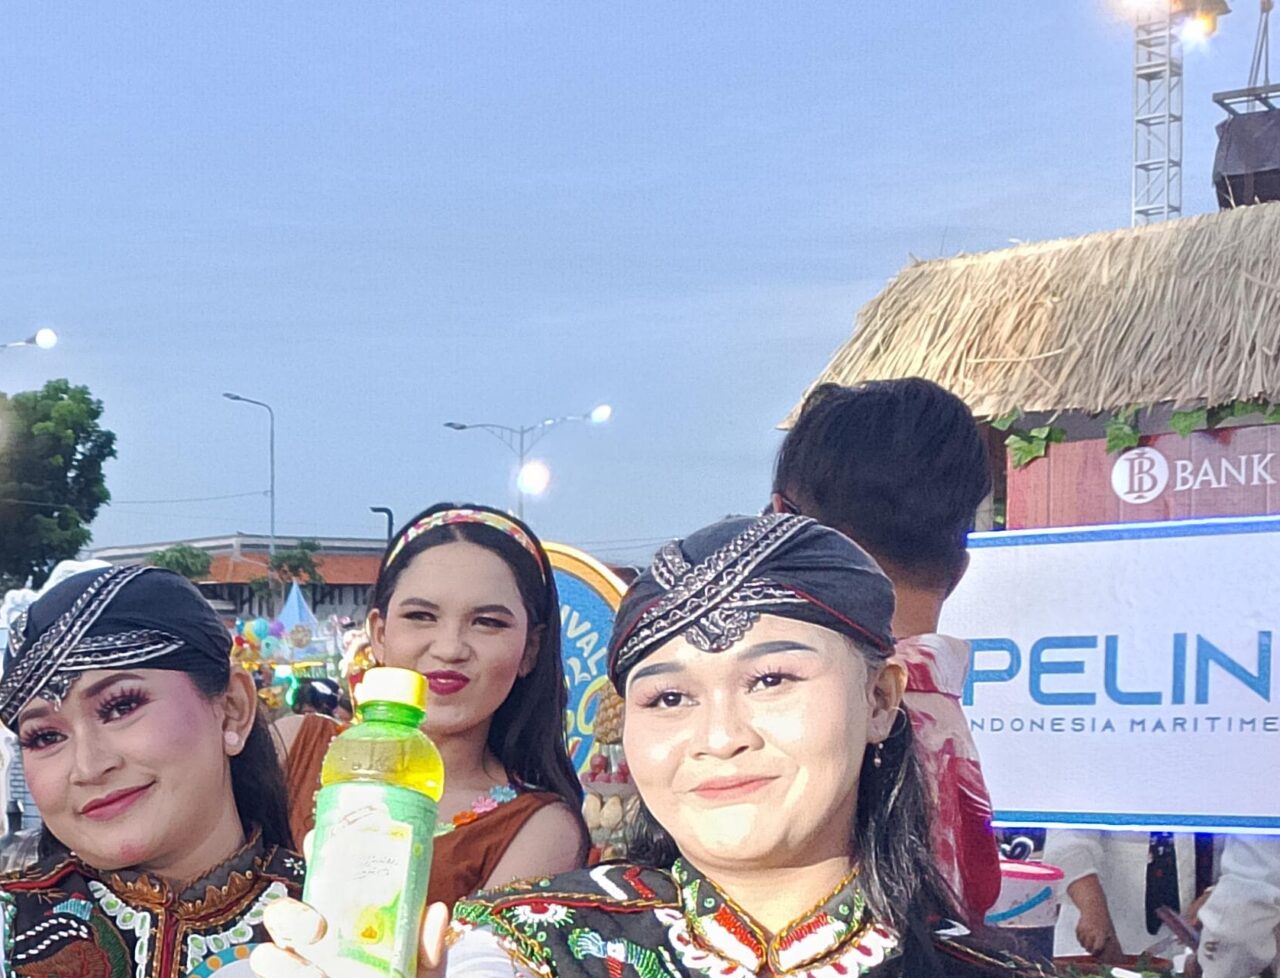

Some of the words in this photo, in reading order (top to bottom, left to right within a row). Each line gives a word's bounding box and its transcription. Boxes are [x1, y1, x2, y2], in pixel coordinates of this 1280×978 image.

[1173, 452, 1277, 492] BANK
[561, 604, 608, 676] IVAL
[970, 716, 1116, 733] NDONESIA
[1128, 716, 1280, 733] MARITIME
